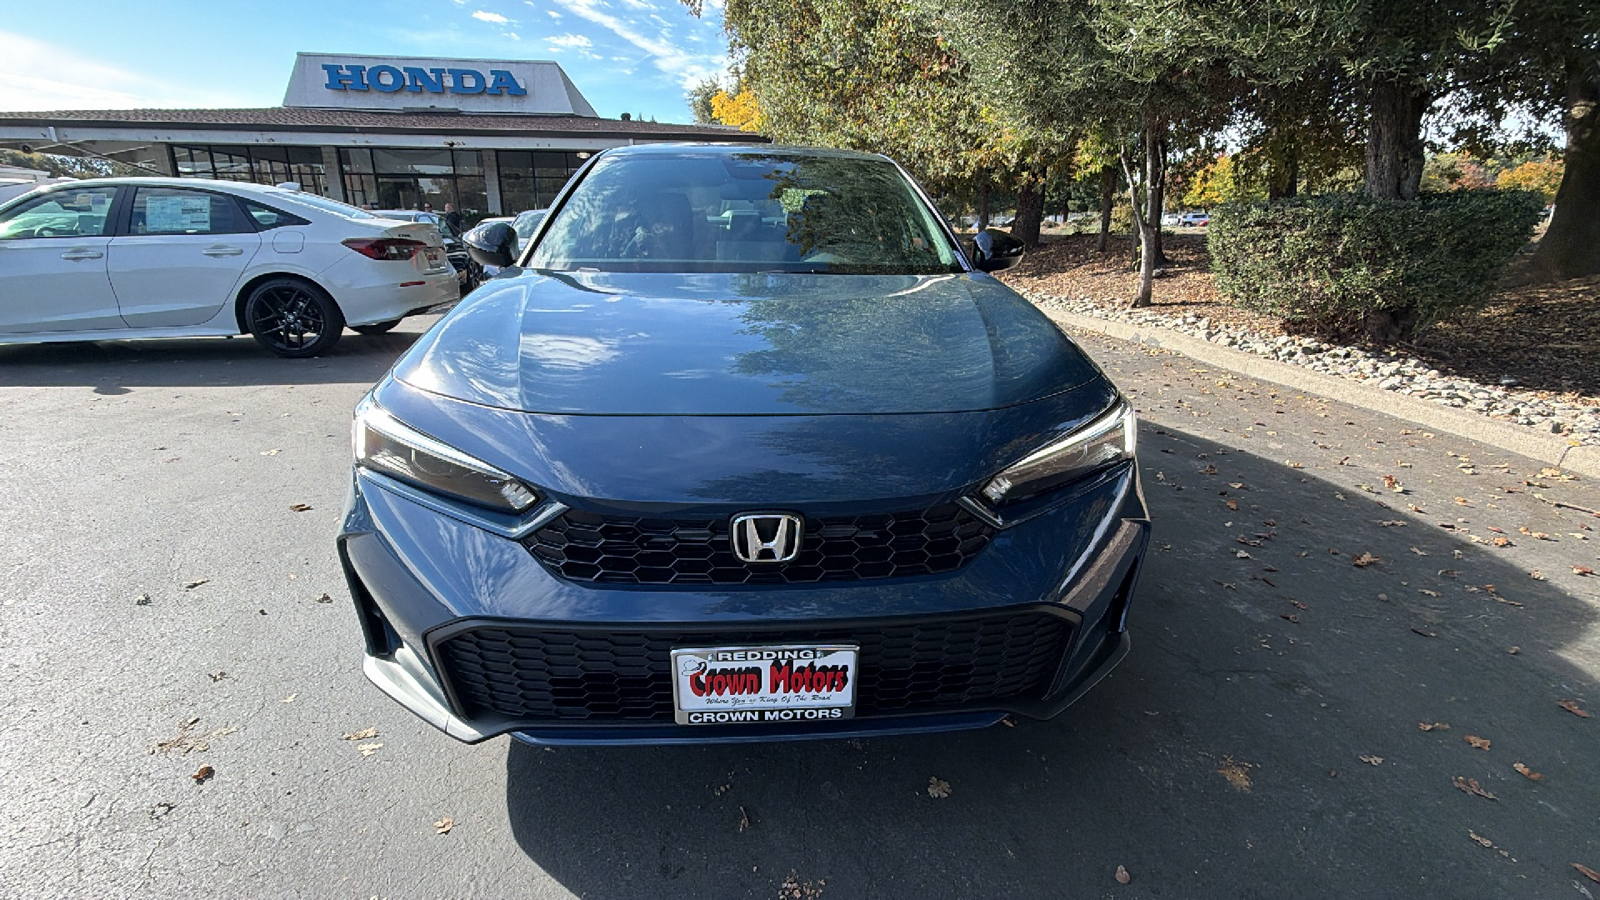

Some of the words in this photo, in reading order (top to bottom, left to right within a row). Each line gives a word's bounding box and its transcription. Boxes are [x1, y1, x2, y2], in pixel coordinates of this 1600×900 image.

[322, 63, 527, 96] HONDA
[718, 650, 814, 662] REDDING
[689, 664, 762, 697] Crown
[769, 661, 849, 694] Motors
[759, 696, 778, 704] King
[781, 695, 791, 703] Of
[794, 694, 807, 702] The
[689, 711, 759, 723] CROWN
[764, 708, 843, 721] MOTORS
